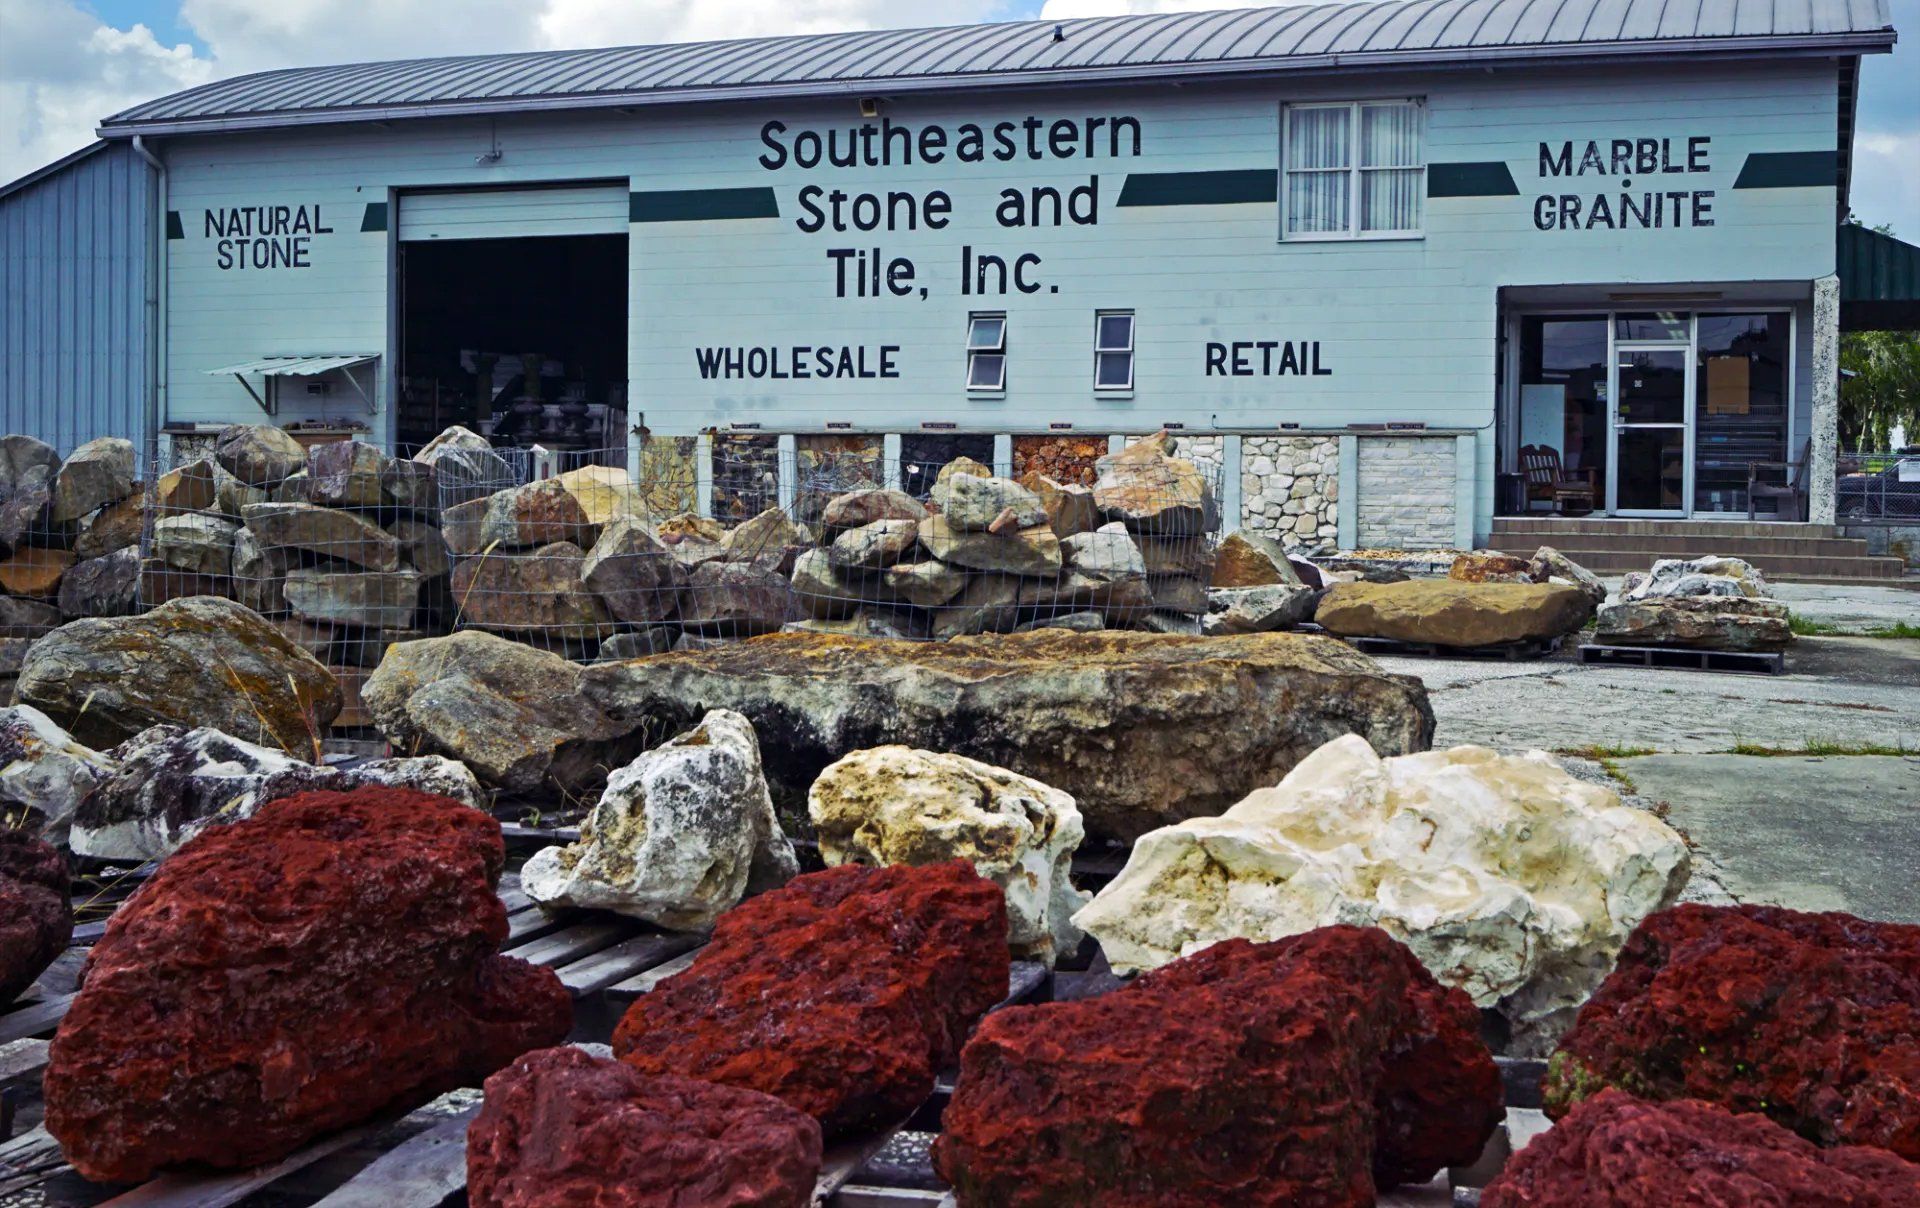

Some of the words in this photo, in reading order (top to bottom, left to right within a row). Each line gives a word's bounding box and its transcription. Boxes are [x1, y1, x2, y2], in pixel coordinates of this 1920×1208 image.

[758, 115, 1142, 171] Southeastern
[1538, 136, 1712, 178] MARBLE
[204, 203, 334, 239] NATURAL
[796, 184, 953, 233] Stone
[995, 174, 1099, 228] and
[1533, 189, 1716, 231] GRANITE
[216, 236, 311, 270] STONE
[826, 247, 929, 301] Tile,
[961, 245, 1059, 295] Inc.
[695, 344, 901, 379] WHOLESALE
[1205, 340, 1333, 377] RETAIL
